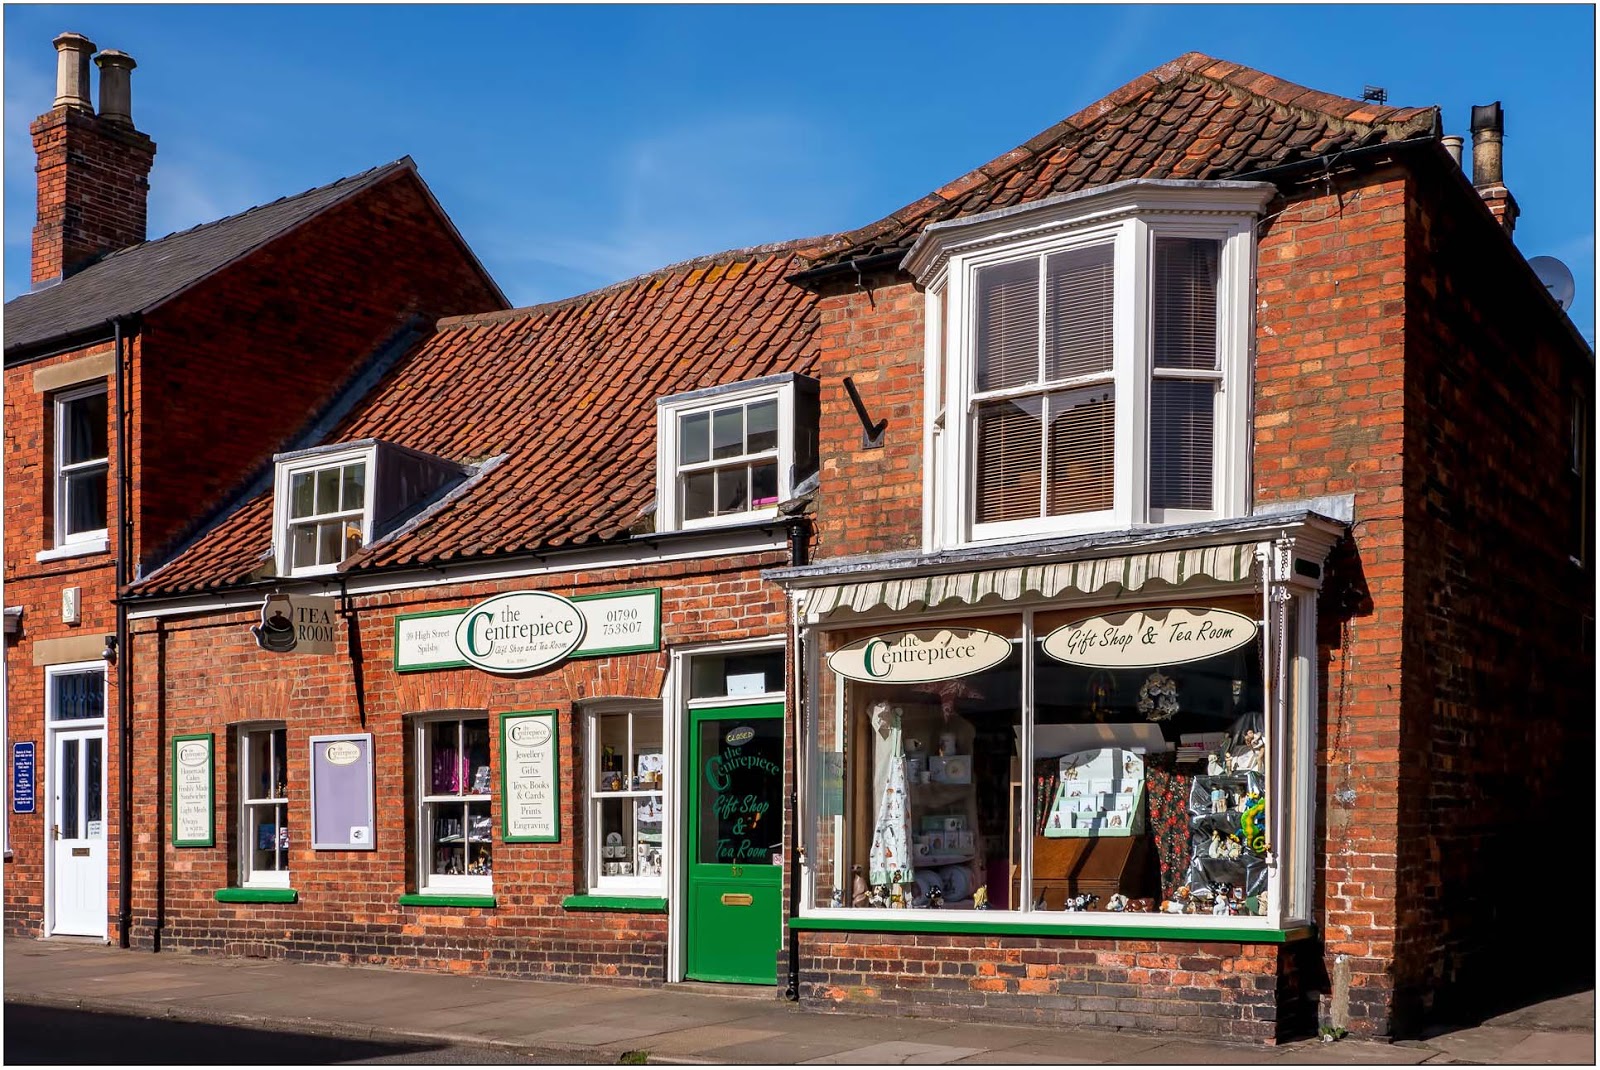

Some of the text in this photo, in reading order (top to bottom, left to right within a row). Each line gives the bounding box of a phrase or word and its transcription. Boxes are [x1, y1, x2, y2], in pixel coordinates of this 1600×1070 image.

[297, 608, 330, 624] TEA
[501, 604, 520, 622] the
[606, 608, 638, 622] 01790
[299, 624, 333, 642] ROOM
[415, 630, 431, 642] High
[431, 630, 450, 639] Street
[466, 612, 573, 657] Centrepiece
[603, 621, 642, 636] 753807
[899, 633, 919, 648] the
[1067, 620, 1235, 654] Gift Shop & Tea Room
[495, 640, 568, 655] Gift Shop and Tea Room
[863, 640, 976, 678] Centrepiece
[727, 731, 753, 742] CLOSED
[515, 749, 545, 761] Jewellery
[724, 746, 742, 760] the
[521, 765, 539, 775] Gifts
[705, 751, 780, 792] Centrepiece
[529, 780, 550, 790] Books
[516, 790, 545, 800] & Cards
[521, 805, 542, 815] Prints
[712, 794, 770, 820] Gift Shop
[513, 820, 550, 831] Engraving
[732, 817, 748, 835] &
[715, 838, 768, 859] Tea Room
